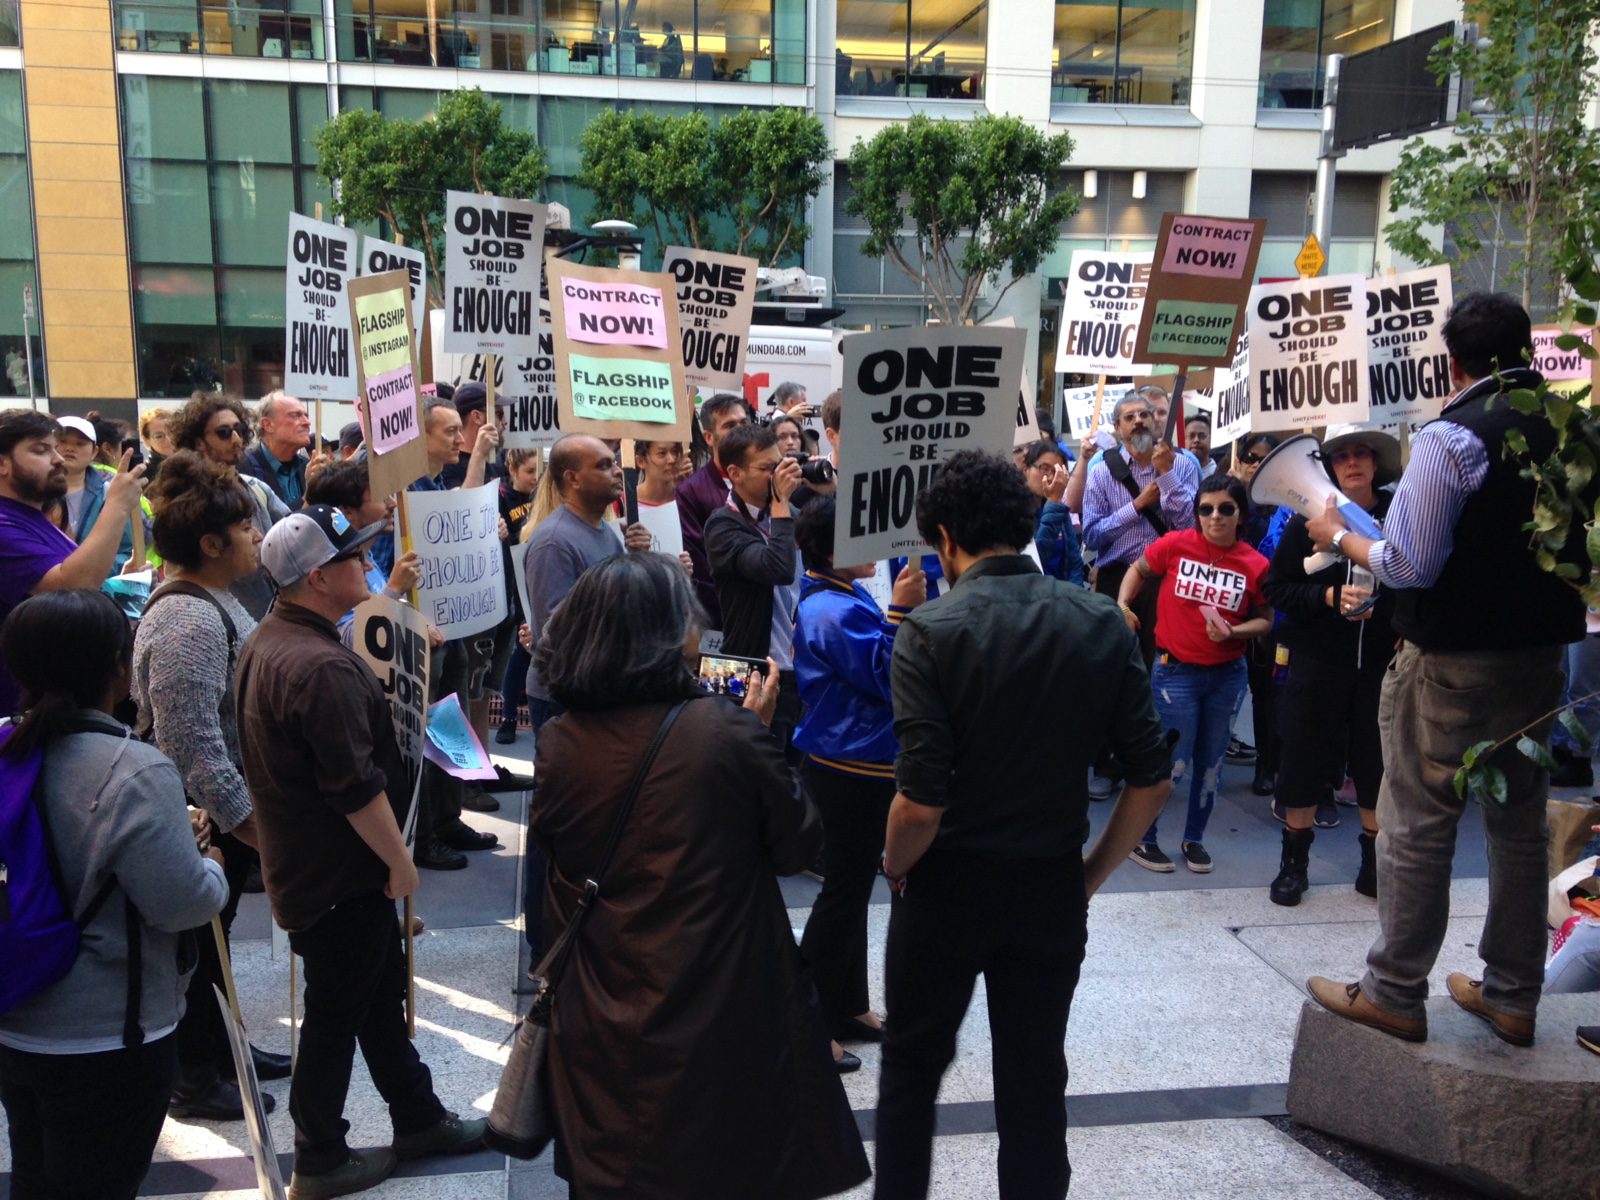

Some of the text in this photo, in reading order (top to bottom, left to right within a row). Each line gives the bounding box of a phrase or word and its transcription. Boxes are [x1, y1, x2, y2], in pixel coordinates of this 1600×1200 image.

[454, 206, 534, 241] ONE
[1173, 224, 1251, 242] CONTRACT
[293, 230, 347, 272] ONE
[462, 239, 525, 259] JOB
[1176, 248, 1237, 269] NOW!
[369, 250, 422, 286] ONE
[469, 259, 517, 274] SHOULD
[668, 258, 746, 292] ONE
[1078, 260, 1152, 284] ONE
[298, 267, 342, 292] JOB
[486, 274, 501, 286] BE
[1084, 284, 1147, 298] JOB
[304, 290, 336, 308] SHOULD
[564, 285, 660, 307] CONTRACT
[677, 286, 736, 307] JOB
[1090, 299, 1138, 311] SHOULD
[1257, 286, 1352, 322] ONE
[316, 310, 326, 322] BE
[360, 308, 405, 334] FLAGSHIP
[453, 287, 532, 336] ENOUGH
[679, 303, 728, 319] SHOULD
[694, 316, 710, 328] BE
[1104, 311, 1120, 321] BE
[1155, 313, 1233, 328] FLAGSHIP
[1367, 310, 1434, 336] JOB
[579, 312, 654, 336] NOW!
[1268, 315, 1346, 340] JOB
[290, 321, 349, 378] ENOUGH
[363, 336, 408, 360] @ INSTAGRAM
[680, 328, 740, 374] OUGH
[747, 344, 806, 356] MUNDO48.COM
[1066, 320, 1135, 359] ENOUG
[1151, 332, 1228, 346] @ FACEBOOK
[1278, 335, 1338, 352] SHOULD
[1372, 330, 1428, 349] SHOULD
[1299, 350, 1318, 363] BE
[1392, 345, 1412, 358] BE
[1533, 356, 1582, 371] NOW!
[518, 357, 556, 372] JO
[858, 346, 1002, 395] ONE
[369, 374, 412, 402] CONTRACT
[524, 373, 556, 382] SHOU
[538, 384, 550, 393] BE
[573, 370, 670, 390] FLAGSHIP
[1259, 359, 1358, 412] ENOUGH
[1369, 354, 1450, 407] NOUGH
[574, 392, 672, 410] @ FACEBOOK
[871, 391, 986, 424] JOB
[1217, 376, 1250, 429] ENOUGH
[380, 406, 412, 440] NOW!
[510, 396, 560, 432] ENOU
[883, 422, 970, 444] SHOULD
[910, 443, 938, 461] BE
[850, 464, 940, 538] ENO
[422, 509, 472, 544] ONE
[416, 552, 486, 590] SHOULD
[1180, 561, 1244, 590] UNITE
[433, 586, 496, 626] ENOUGH
[1176, 578, 1239, 610] HERE!
[365, 615, 426, 686] ONE
[378, 667, 423, 716] JOB
[400, 727, 411, 752] BE
